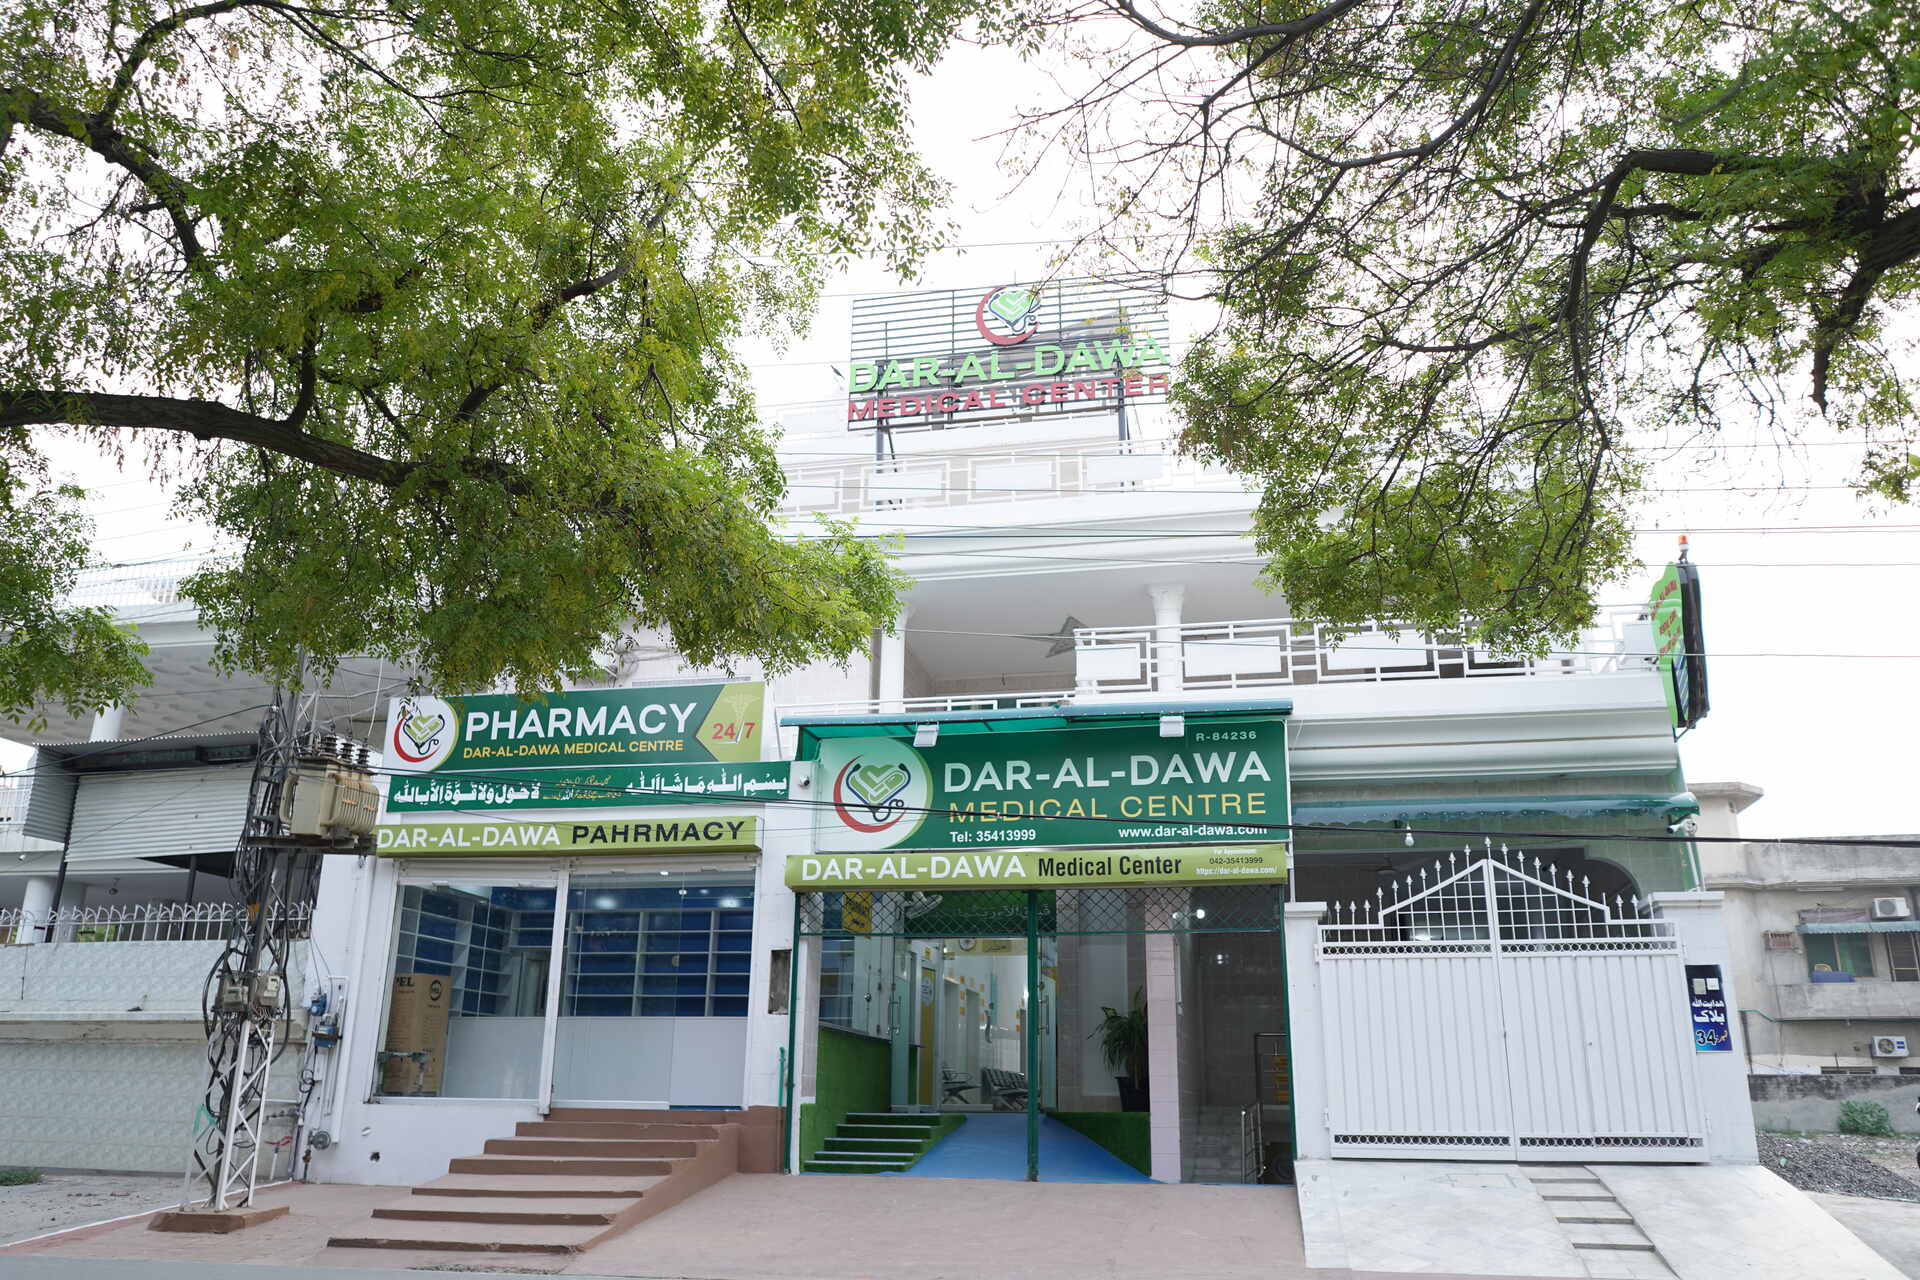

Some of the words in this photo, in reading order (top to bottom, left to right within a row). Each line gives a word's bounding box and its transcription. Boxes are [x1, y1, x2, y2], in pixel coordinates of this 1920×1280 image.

[849, 338, 1171, 393] DAR-AL-DAWA
[848, 389, 1007, 422] MEDICAL
[1022, 374, 1169, 405] CENTER
[465, 702, 697, 741] PHARMACY
[712, 722, 755, 744] 24/7
[463, 744, 560, 759] DAR-AL-DAWA
[564, 741, 625, 755] MEDICAL
[629, 739, 684, 753] CENTRE
[1195, 731, 1257, 742] R-84236
[944, 751, 1271, 793] DAR-AL-DAWA
[949, 795, 1108, 824] MEDICAL
[1120, 792, 1266, 818] CENTRE
[377, 824, 561, 848] DAR-AL-DAWA
[572, 820, 745, 845] PAHRMACY
[950, 831, 973, 844] Tel:
[976, 829, 1036, 843] 35413999
[1118, 824, 1268, 838] www.dar-al-dawa.com
[801, 854, 1027, 882] DAR-AL-DAWA
[1038, 855, 1112, 877] Medical
[1119, 855, 1182, 876] Center
[1696, 1029, 1717, 1046] 34
